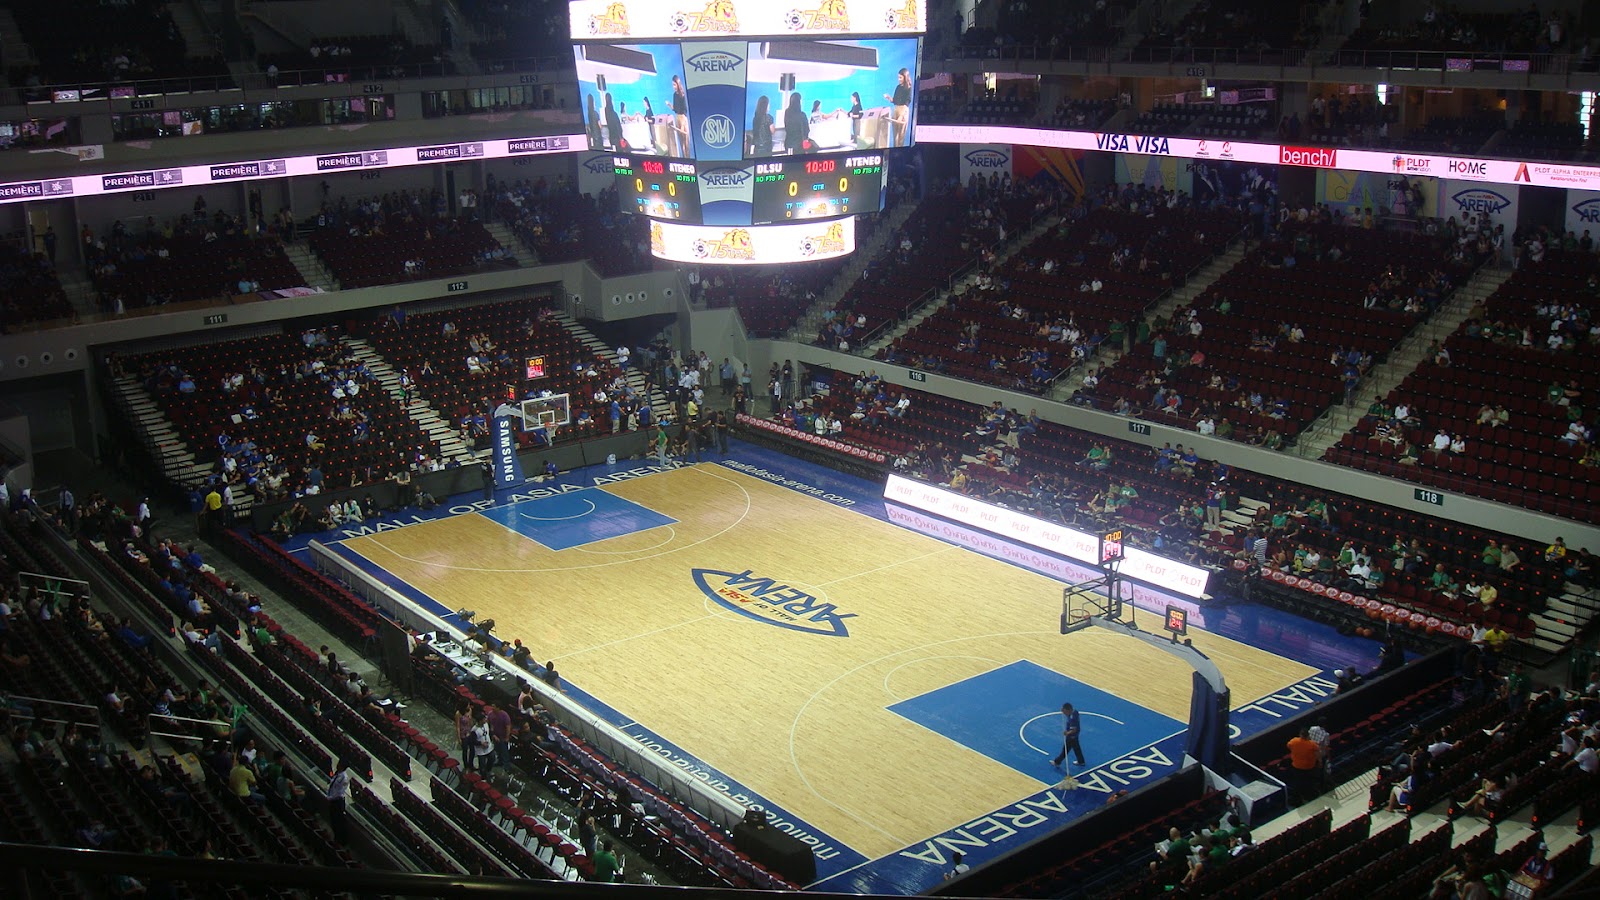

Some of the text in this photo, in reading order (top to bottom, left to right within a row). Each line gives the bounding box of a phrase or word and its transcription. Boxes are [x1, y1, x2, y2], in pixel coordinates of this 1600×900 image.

[694, 60, 735, 72] ARENA
[704, 118, 730, 144] SM
[509, 140, 546, 150] PREMIÈRE
[1094, 133, 1170, 155] VISA VISA
[418, 147, 459, 158] PREMIÈRE
[318, 156, 361, 167] PREMIÈRE
[757, 156, 881, 174] DLSU 10:00 ATENEO
[970, 158, 1004, 168] ARENA
[1407, 158, 1431, 167] PLDT
[1449, 160, 1487, 175] HOME
[212, 165, 258, 177] PREMIÈRE
[590, 163, 613, 174] ARE
[104, 175, 152, 187] PREMIÈRE
[707, 175, 744, 186] ARENA
[0, 184, 41, 198] REMIÈRE
[636, 178, 643, 192] 0
[668, 182, 676, 197] 0
[789, 181, 798, 197] 0
[839, 178, 848, 192] 0
[1459, 198, 1501, 214] ARENA
[451, 282, 465, 291] 112
[209, 314, 223, 324] 111
[1132, 423, 1145, 434] 117
[500, 420, 515, 482] SAMSUNG
[342, 461, 689, 538] MALL OF ASIA ARENA
[1420, 490, 1438, 503] 118
[980, 511, 998, 523] PLDT
[1011, 521, 1030, 533] PLDT
[1041, 531, 1062, 543] PLDT
[1075, 541, 1096, 554] PLDT
[1145, 563, 1167, 577] PLDT
[1180, 574, 1203, 588] PLDT
[718, 587, 754, 604] ASIA
[724, 569, 859, 622] ARENA
[769, 609, 798, 621] MALL
[898, 676, 1340, 866] MALL ASIA ARENA
